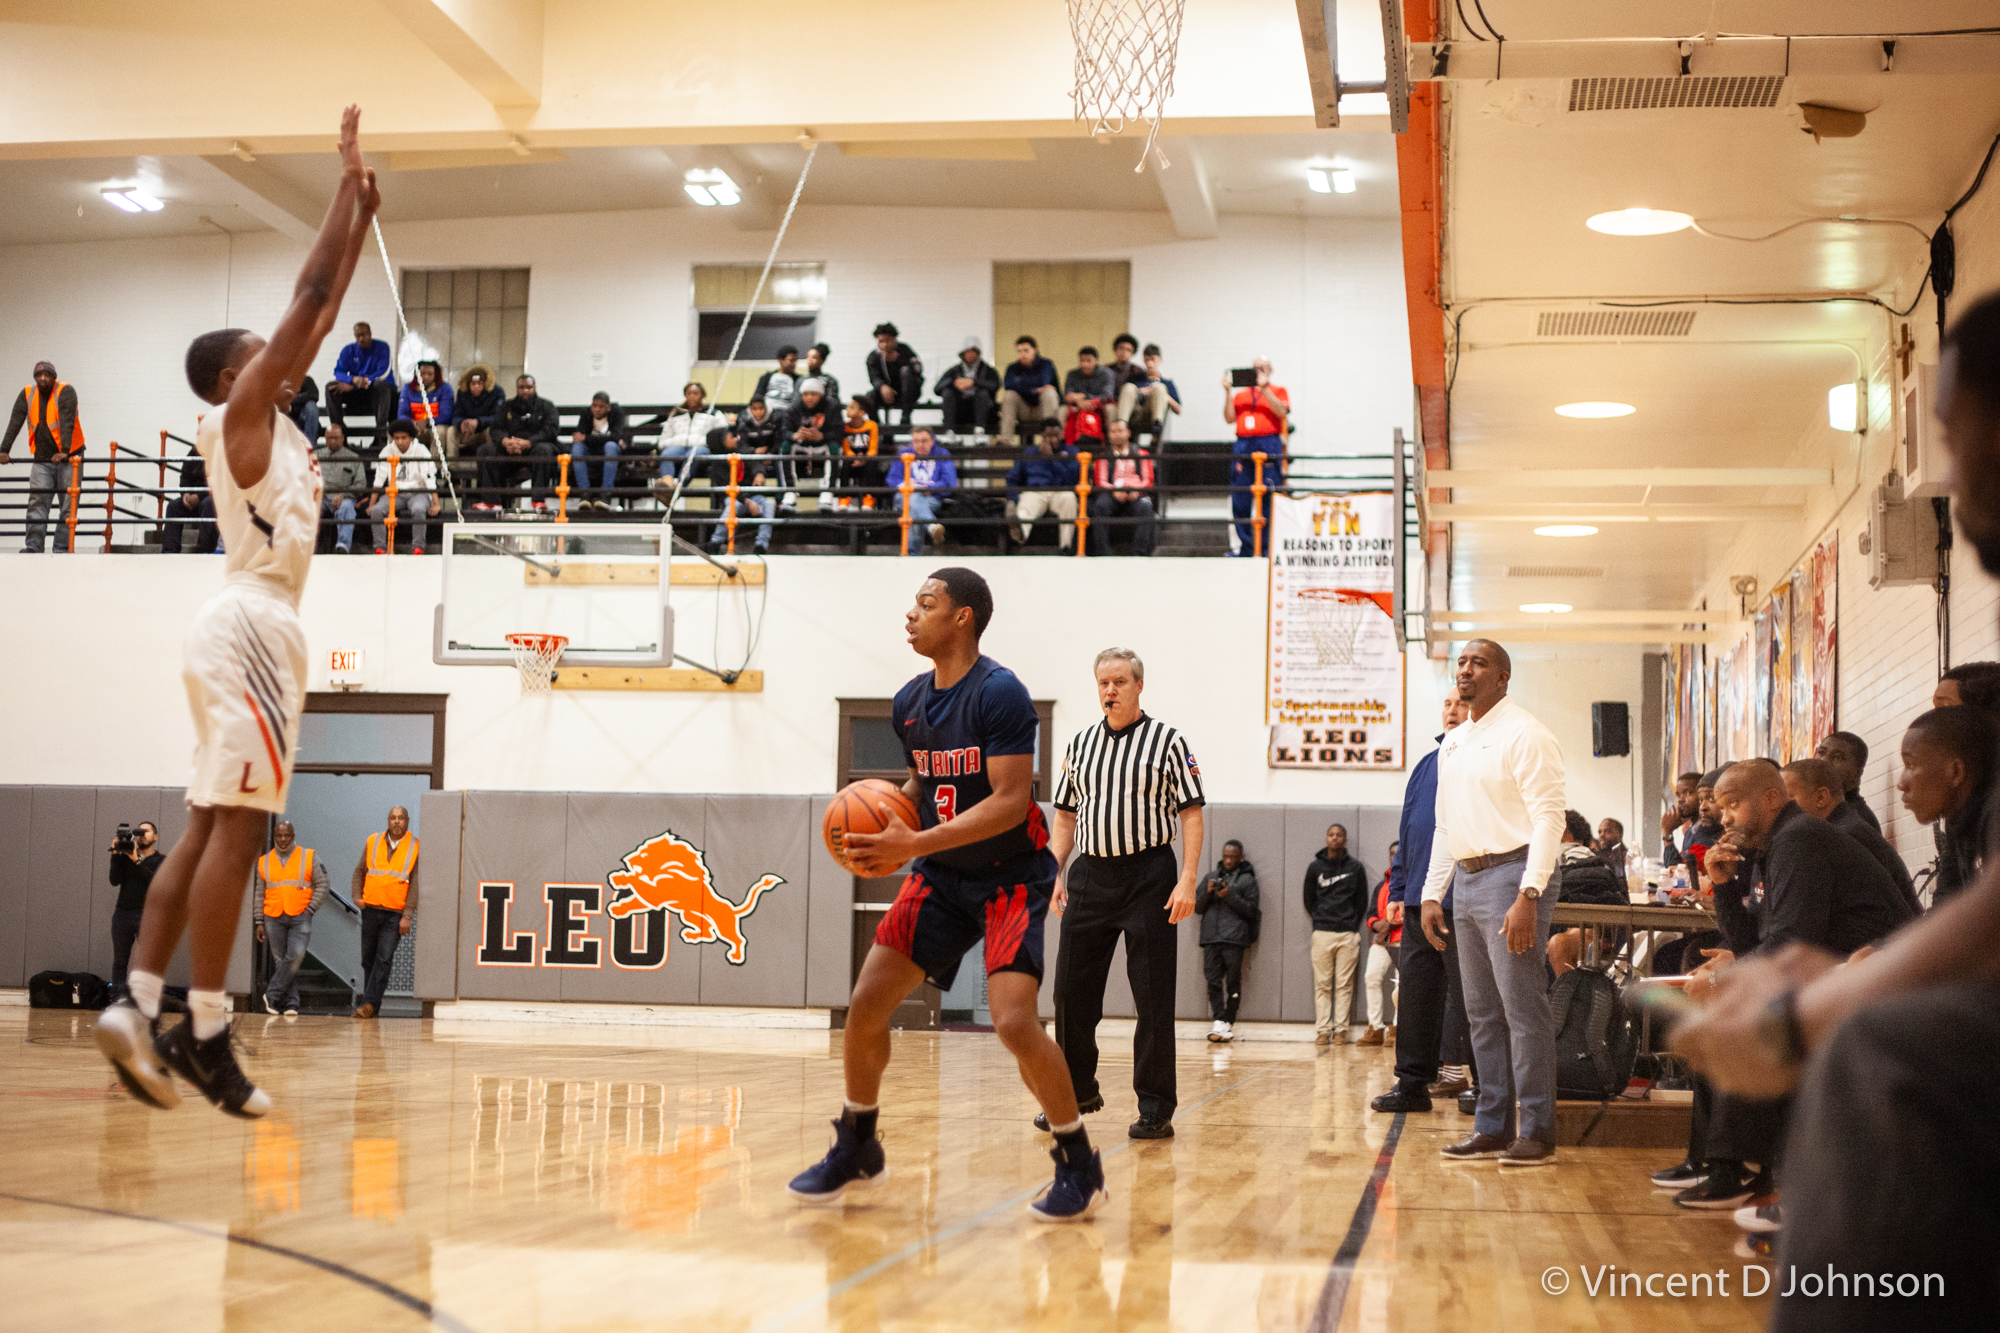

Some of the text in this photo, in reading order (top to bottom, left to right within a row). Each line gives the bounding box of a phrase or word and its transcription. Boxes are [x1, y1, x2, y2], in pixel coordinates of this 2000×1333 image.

[1313, 513, 1360, 536] TEN
[1284, 539, 1334, 551] REASONS
[1339, 539, 1352, 551] TO
[1275, 555, 1281, 566] A
[1287, 555, 1339, 566] WINNING
[332, 651, 357, 670] EXIT
[1286, 699, 1386, 713] Sportsmanship
[1279, 711, 1391, 726] begins with you!
[1303, 729, 1367, 744] LEO
[932, 746, 980, 776] RITA
[1277, 748, 1393, 762] LIONS
[238, 761, 259, 793] L
[934, 784, 957, 824] 3
[476, 881, 669, 970] LEO
